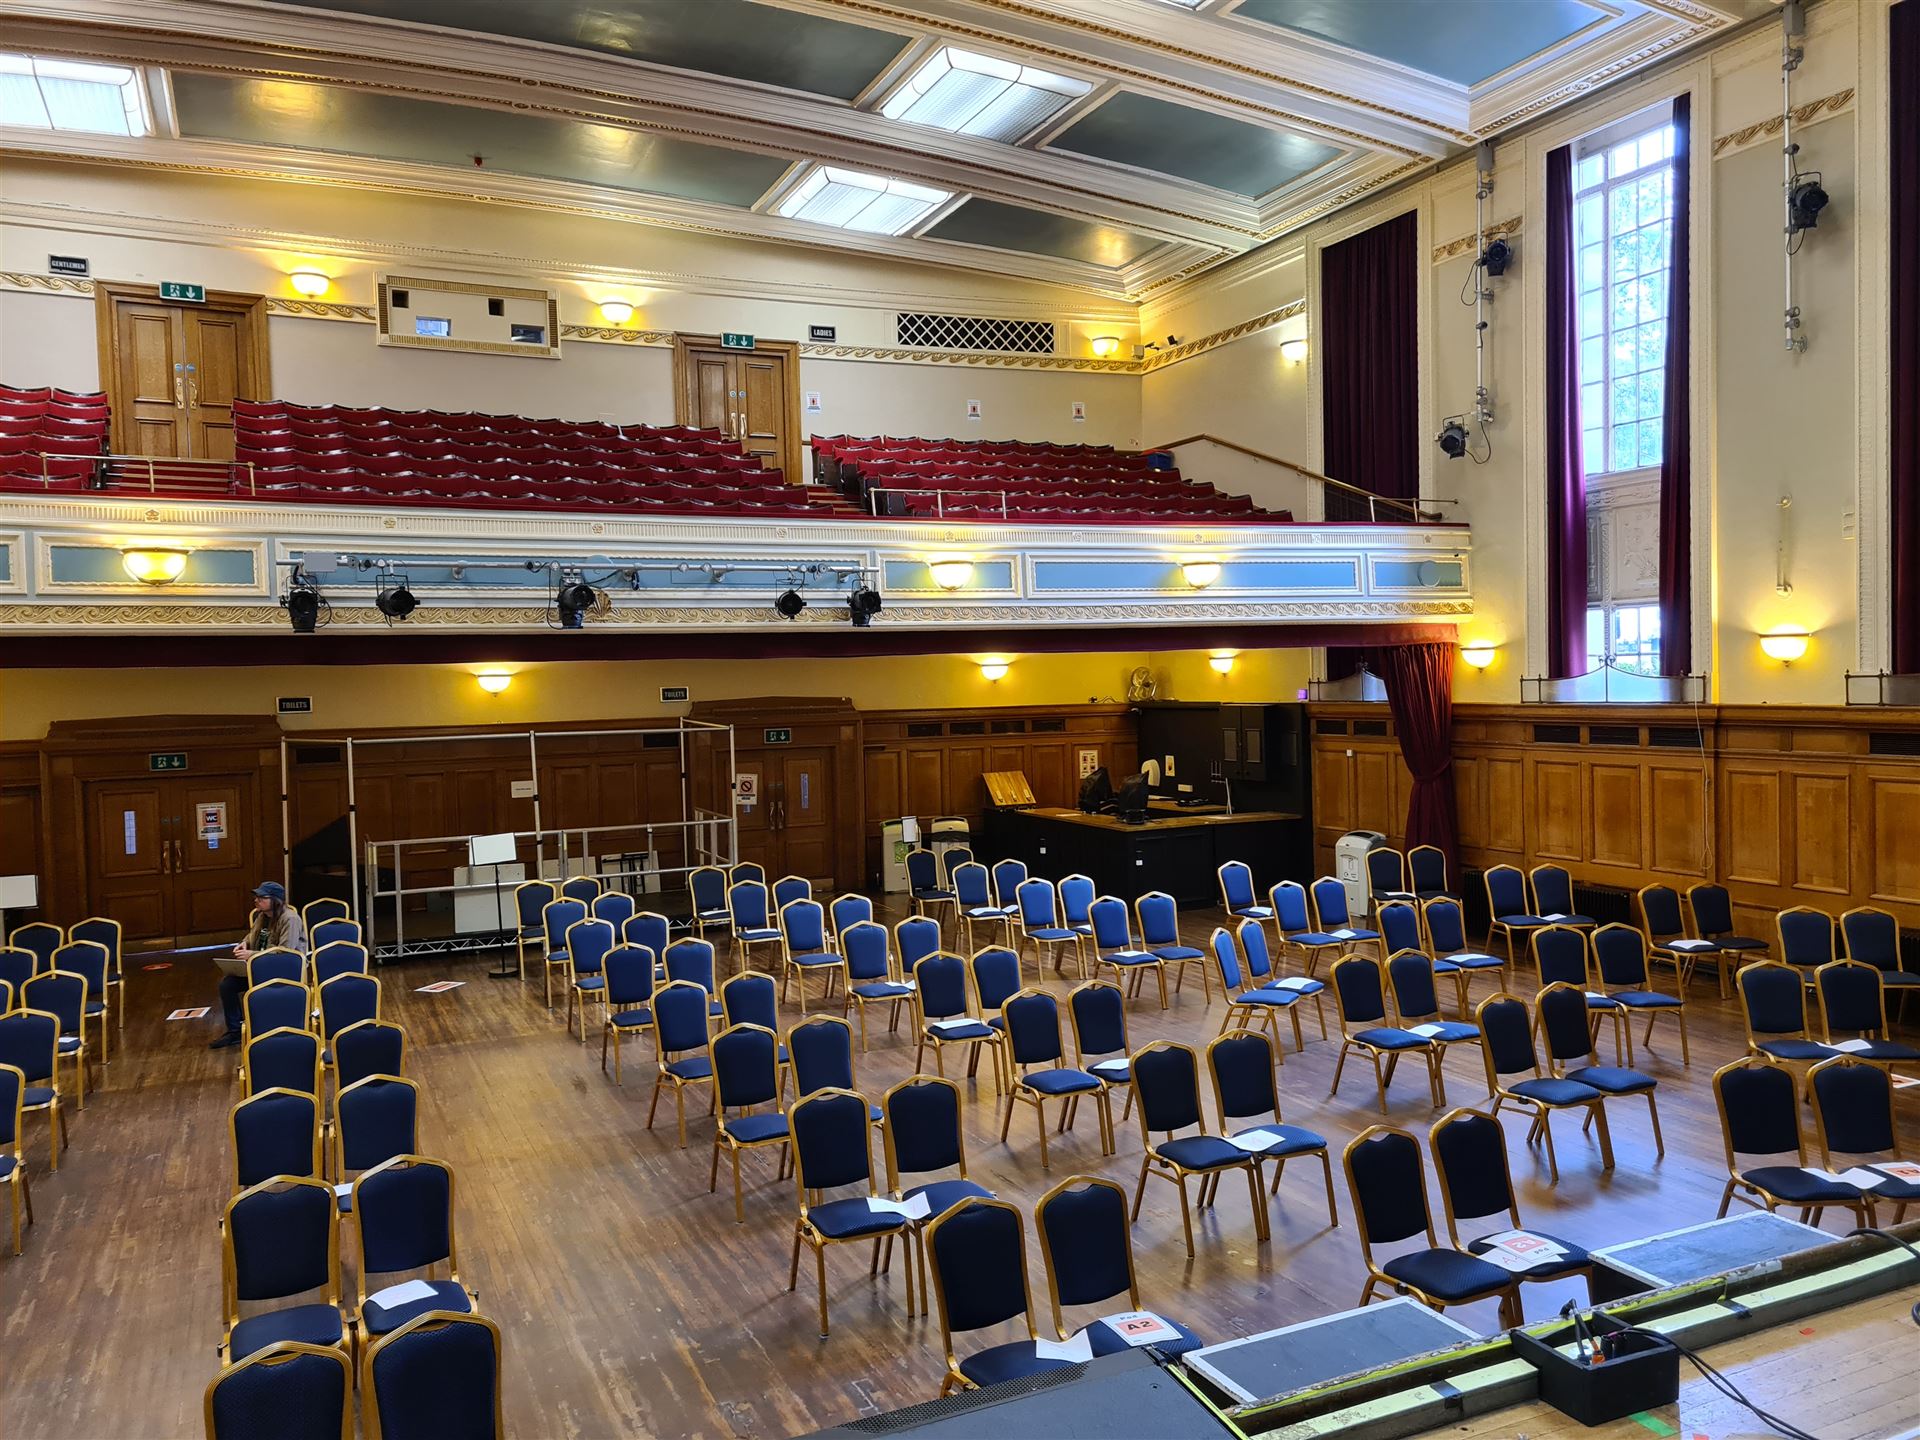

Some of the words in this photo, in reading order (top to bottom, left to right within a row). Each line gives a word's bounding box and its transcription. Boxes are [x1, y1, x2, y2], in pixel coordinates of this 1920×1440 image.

[813, 329, 833, 337] LADIES
[281, 701, 308, 709] TOILETS
[1127, 1321, 1153, 1331] A2
